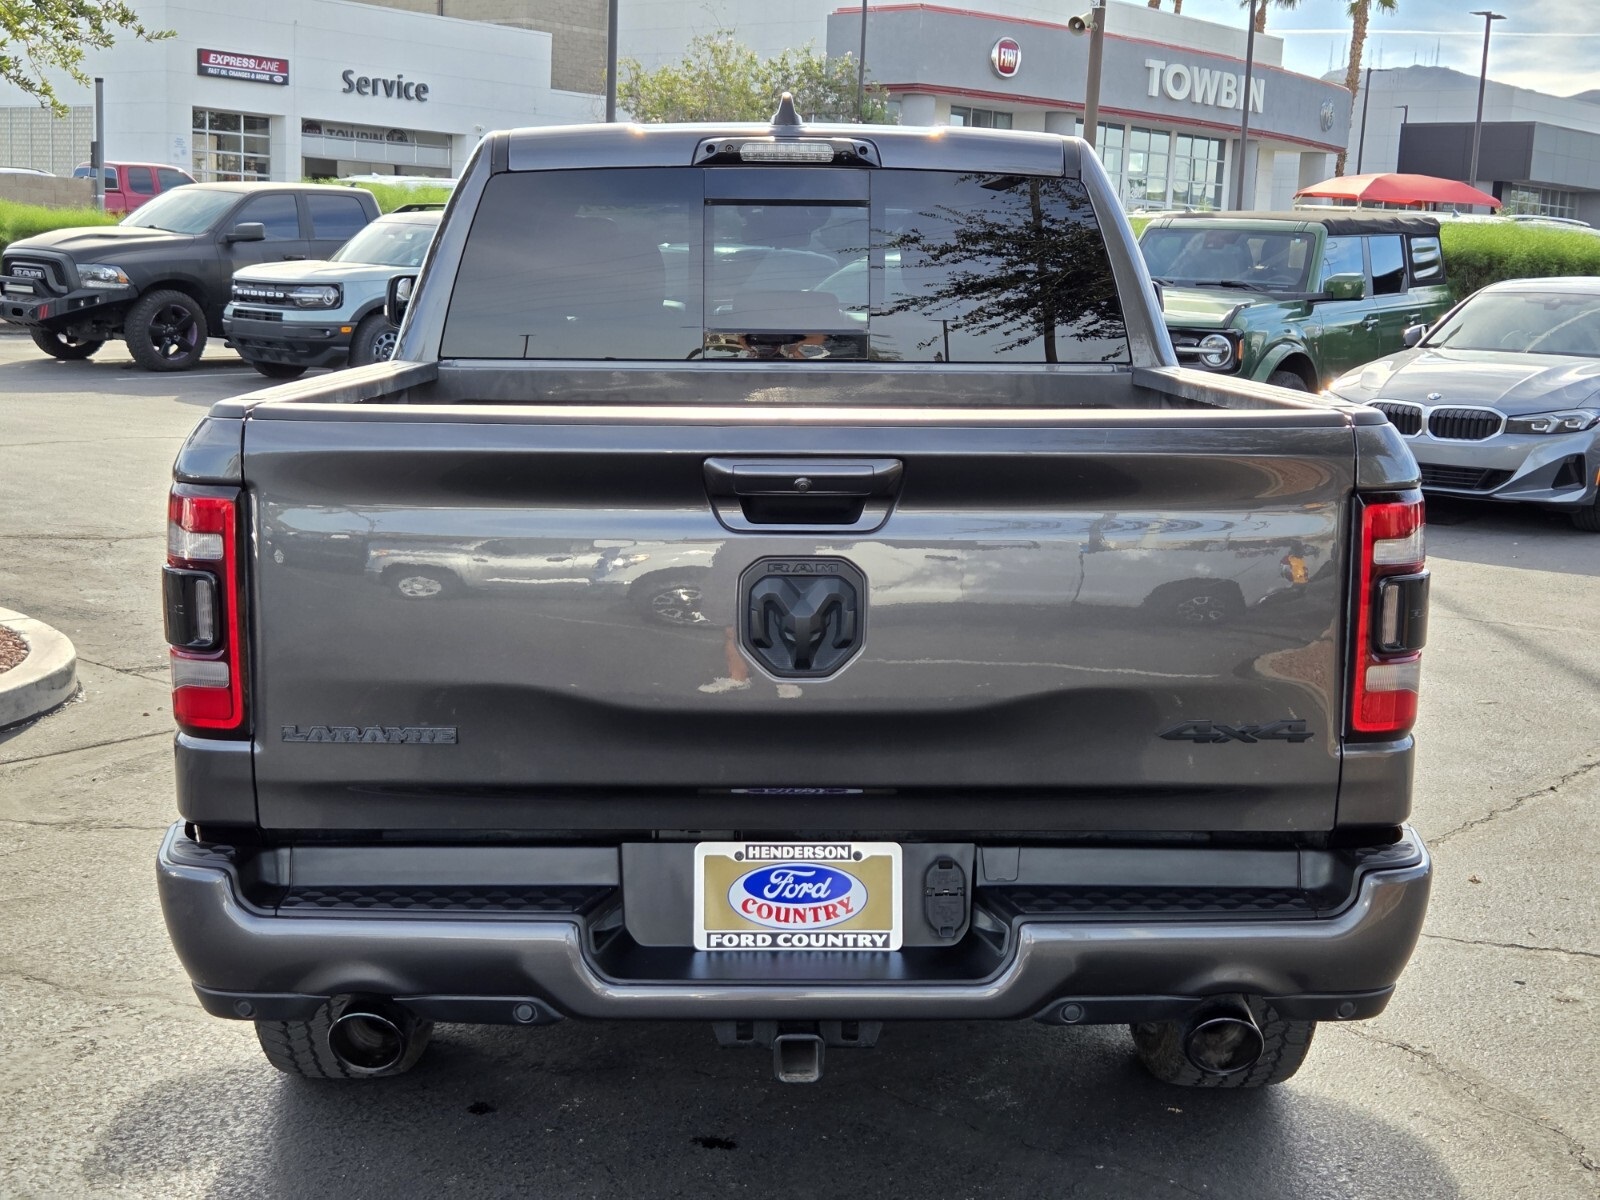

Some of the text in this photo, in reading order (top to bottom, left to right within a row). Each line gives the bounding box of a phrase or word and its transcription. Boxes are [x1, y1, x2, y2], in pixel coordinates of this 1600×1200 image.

[1000, 47, 1018, 68] FIAT
[207, 67, 220, 75] FAST
[228, 70, 251, 78] CHANGES
[255, 73, 270, 81] MORE
[342, 69, 429, 102] Service
[1144, 58, 1266, 114] TOWBIN
[13, 269, 42, 278] RAM
[236, 289, 285, 298] BRONCO
[767, 563, 839, 573] RAM
[281, 725, 458, 744] LARAMIE
[747, 846, 849, 859] HENDERSON
[763, 869, 833, 899] Ford
[741, 896, 854, 924] COUNTRY
[709, 934, 888, 947] FORD COUNTRY
